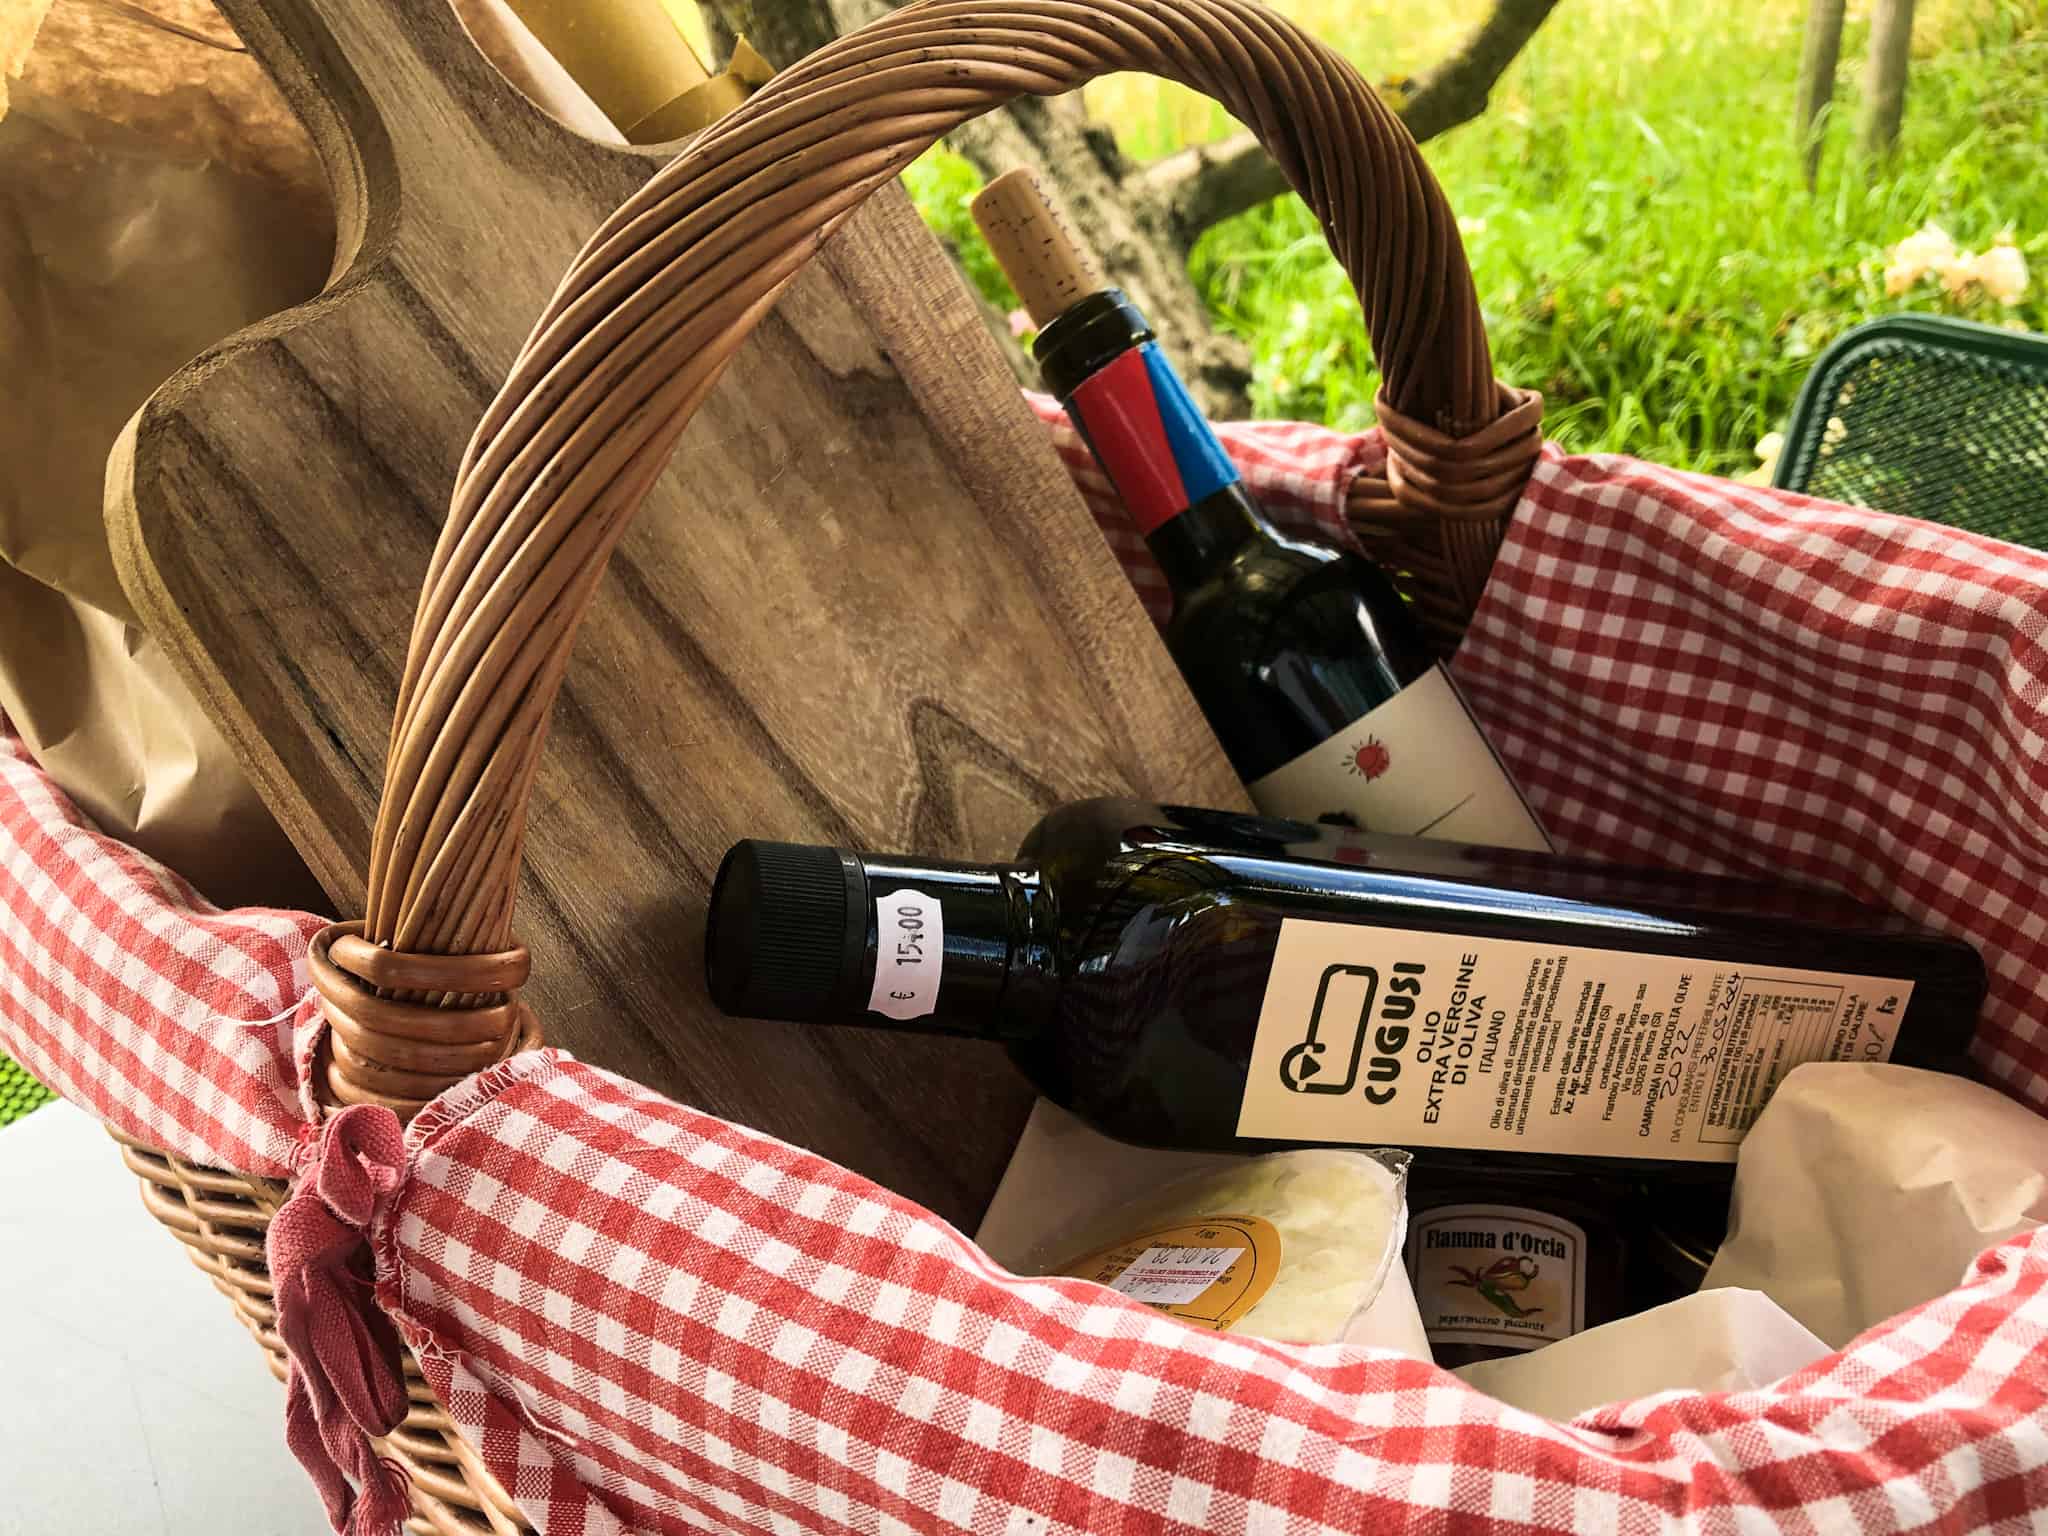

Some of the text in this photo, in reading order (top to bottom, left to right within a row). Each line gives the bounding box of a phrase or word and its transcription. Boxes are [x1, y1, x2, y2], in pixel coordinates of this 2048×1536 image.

[1528, 993, 1544, 1018] dalle
[1537, 967, 1552, 991] olive
[1364, 962, 1426, 1105] CUGUSI
[1415, 1010, 1441, 1063] OLIO
[1422, 952, 1478, 1123] EXTRA VERGINE
[1450, 994, 1486, 1084] DI OLIVA
[1478, 1009, 1506, 1073] ITALIANO
[1488, 957, 1541, 1128] Olio di oliva di categoria superiore
[1511, 1020, 1537, 1086] direttamente
[1512, 955, 1568, 1134] unicamente mediante procedimenti
[1540, 1020, 1562, 1071] meccanici
[1549, 980, 1593, 1114] Estratto dalle olive aziendali
[1562, 982, 1605, 1113] Az. Agr. Cugusi Giovannina
[1579, 1021, 1606, 1095] Montepulciano
[1597, 1012, 1626, 1089] confezionato da
[1601, 1082, 1620, 1120] Frantoio
[1611, 1037, 1631, 1080] Armellini
[1623, 1002, 1641, 1034] Pienza
[1637, 973, 1691, 1136] CAMPAGNA DI RACCOLTA OLIVE
[1639, 1029, 1657, 1062] Pienza
[1658, 1022, 1696, 1100] 2022
[1502, 1087, 1521, 1130] ottenuto
[1620, 1077, 1632, 1092] Via
[1631, 1063, 1648, 1095] 53026
[1669, 1127, 1682, 1142] DA
[1426, 1230, 1566, 1259] Fiamma d'Orcia
